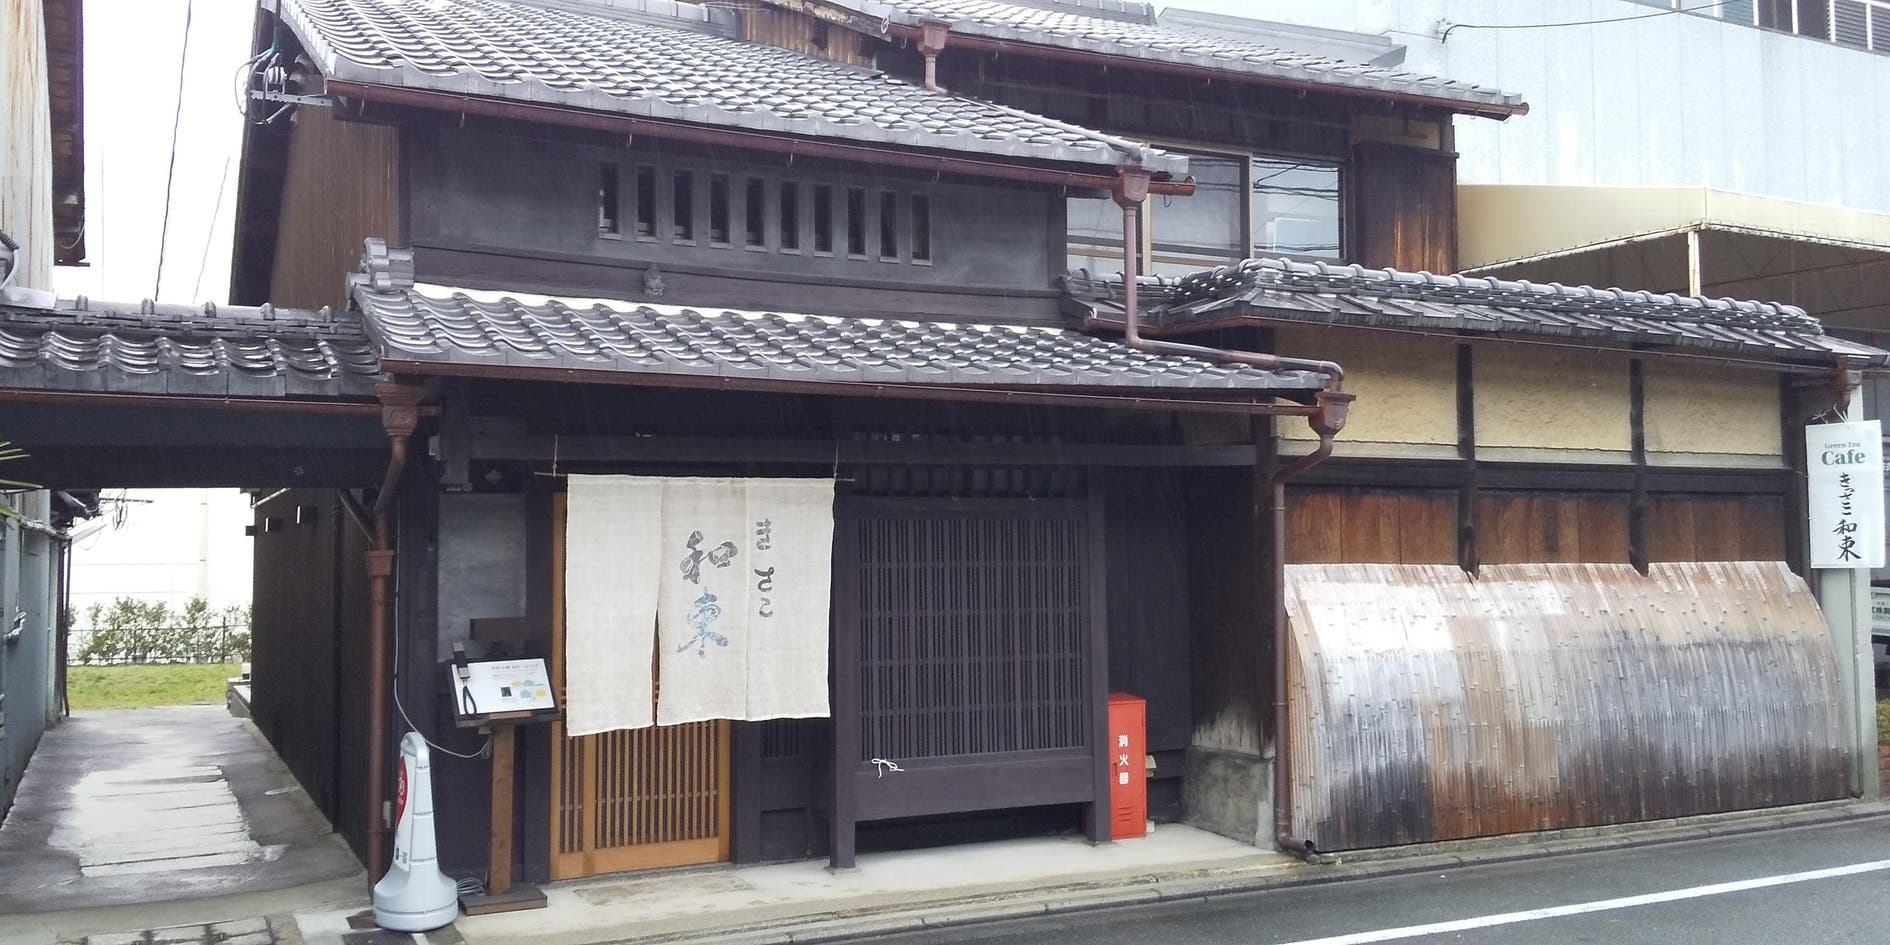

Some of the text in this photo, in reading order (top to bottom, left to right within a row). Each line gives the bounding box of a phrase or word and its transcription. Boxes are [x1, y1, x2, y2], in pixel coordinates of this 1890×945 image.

[1821, 449, 1866, 466] Cafe
[1118, 734, 1130, 785] 消火器
